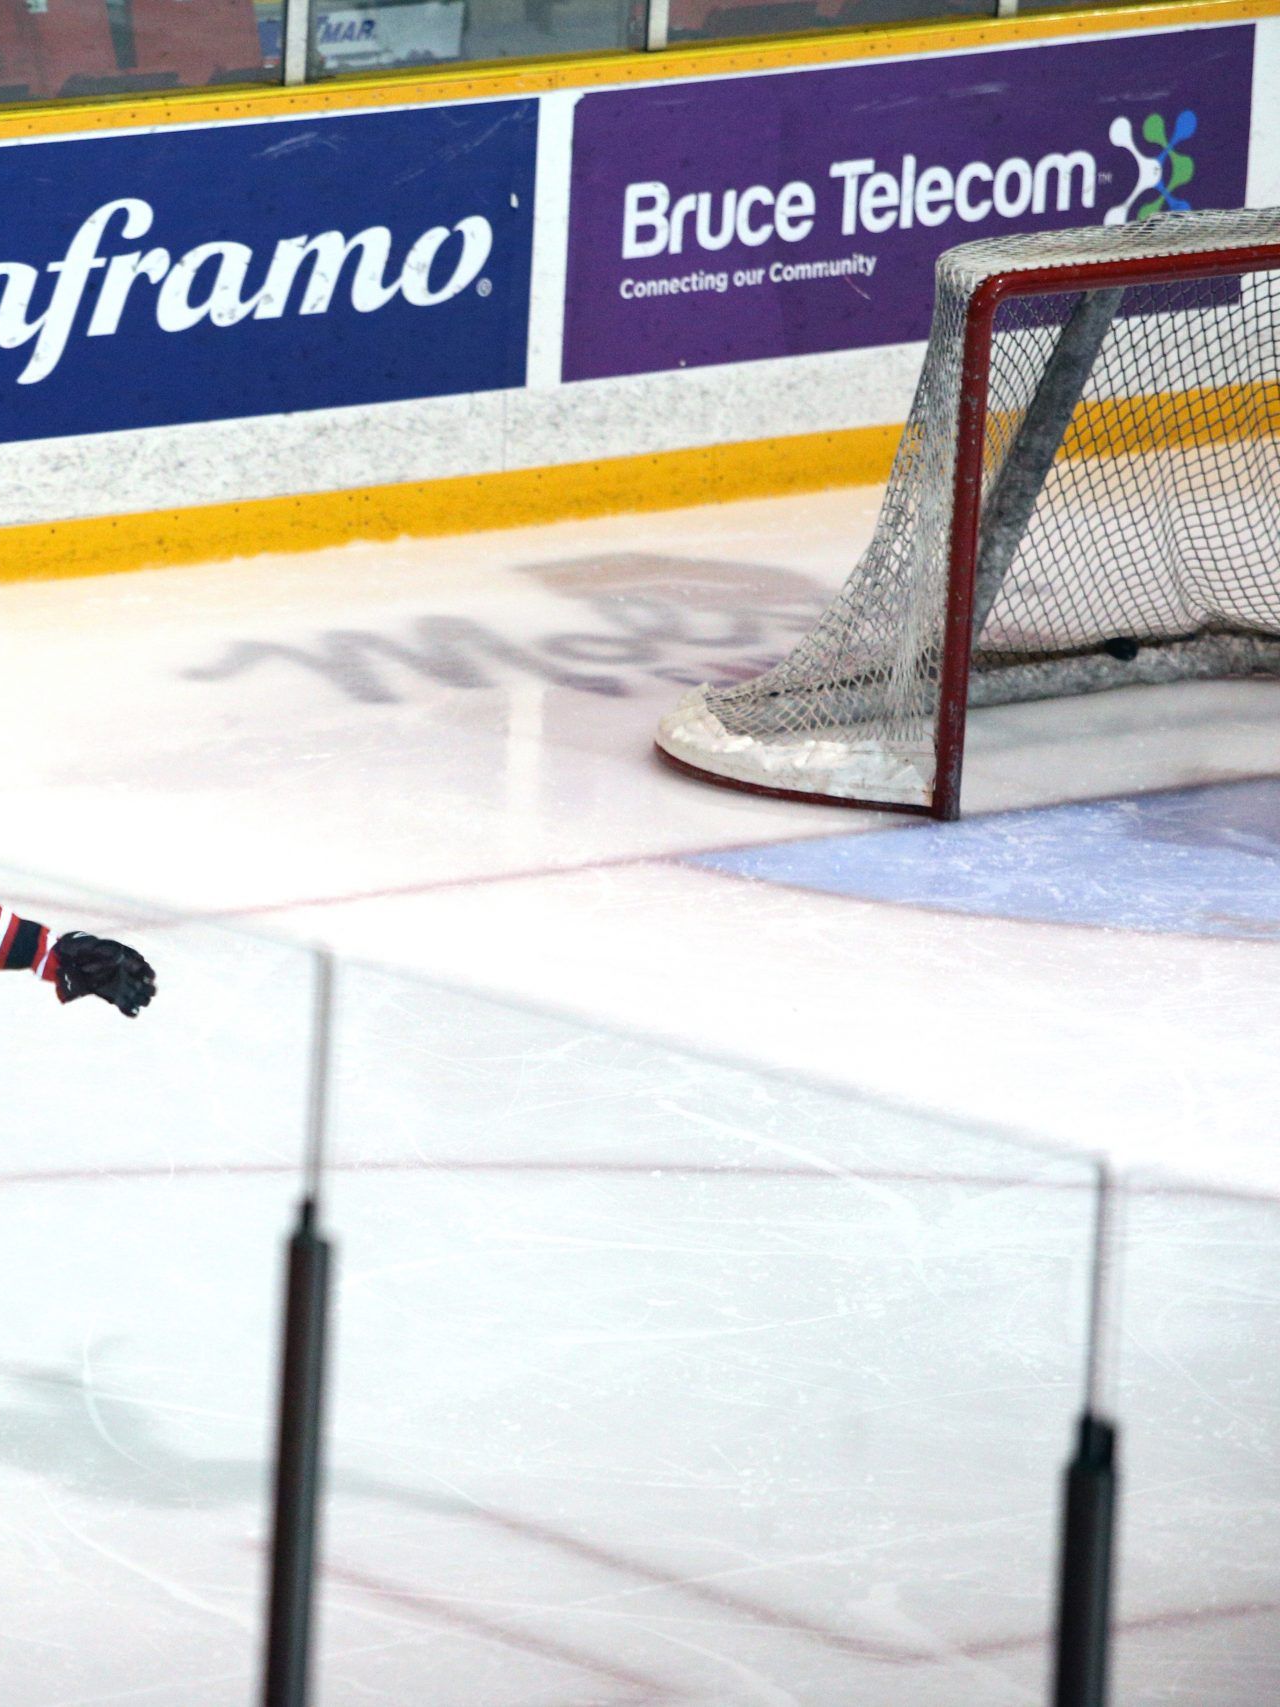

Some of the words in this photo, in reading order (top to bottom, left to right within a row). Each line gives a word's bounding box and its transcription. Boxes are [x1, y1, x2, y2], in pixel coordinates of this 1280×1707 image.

[622, 181, 816, 259] Bruce
[829, 151, 1096, 236] Telecom
[620, 269, 728, 299] Connecting
[733, 267, 766, 288] our
[769, 252, 877, 283] Community
